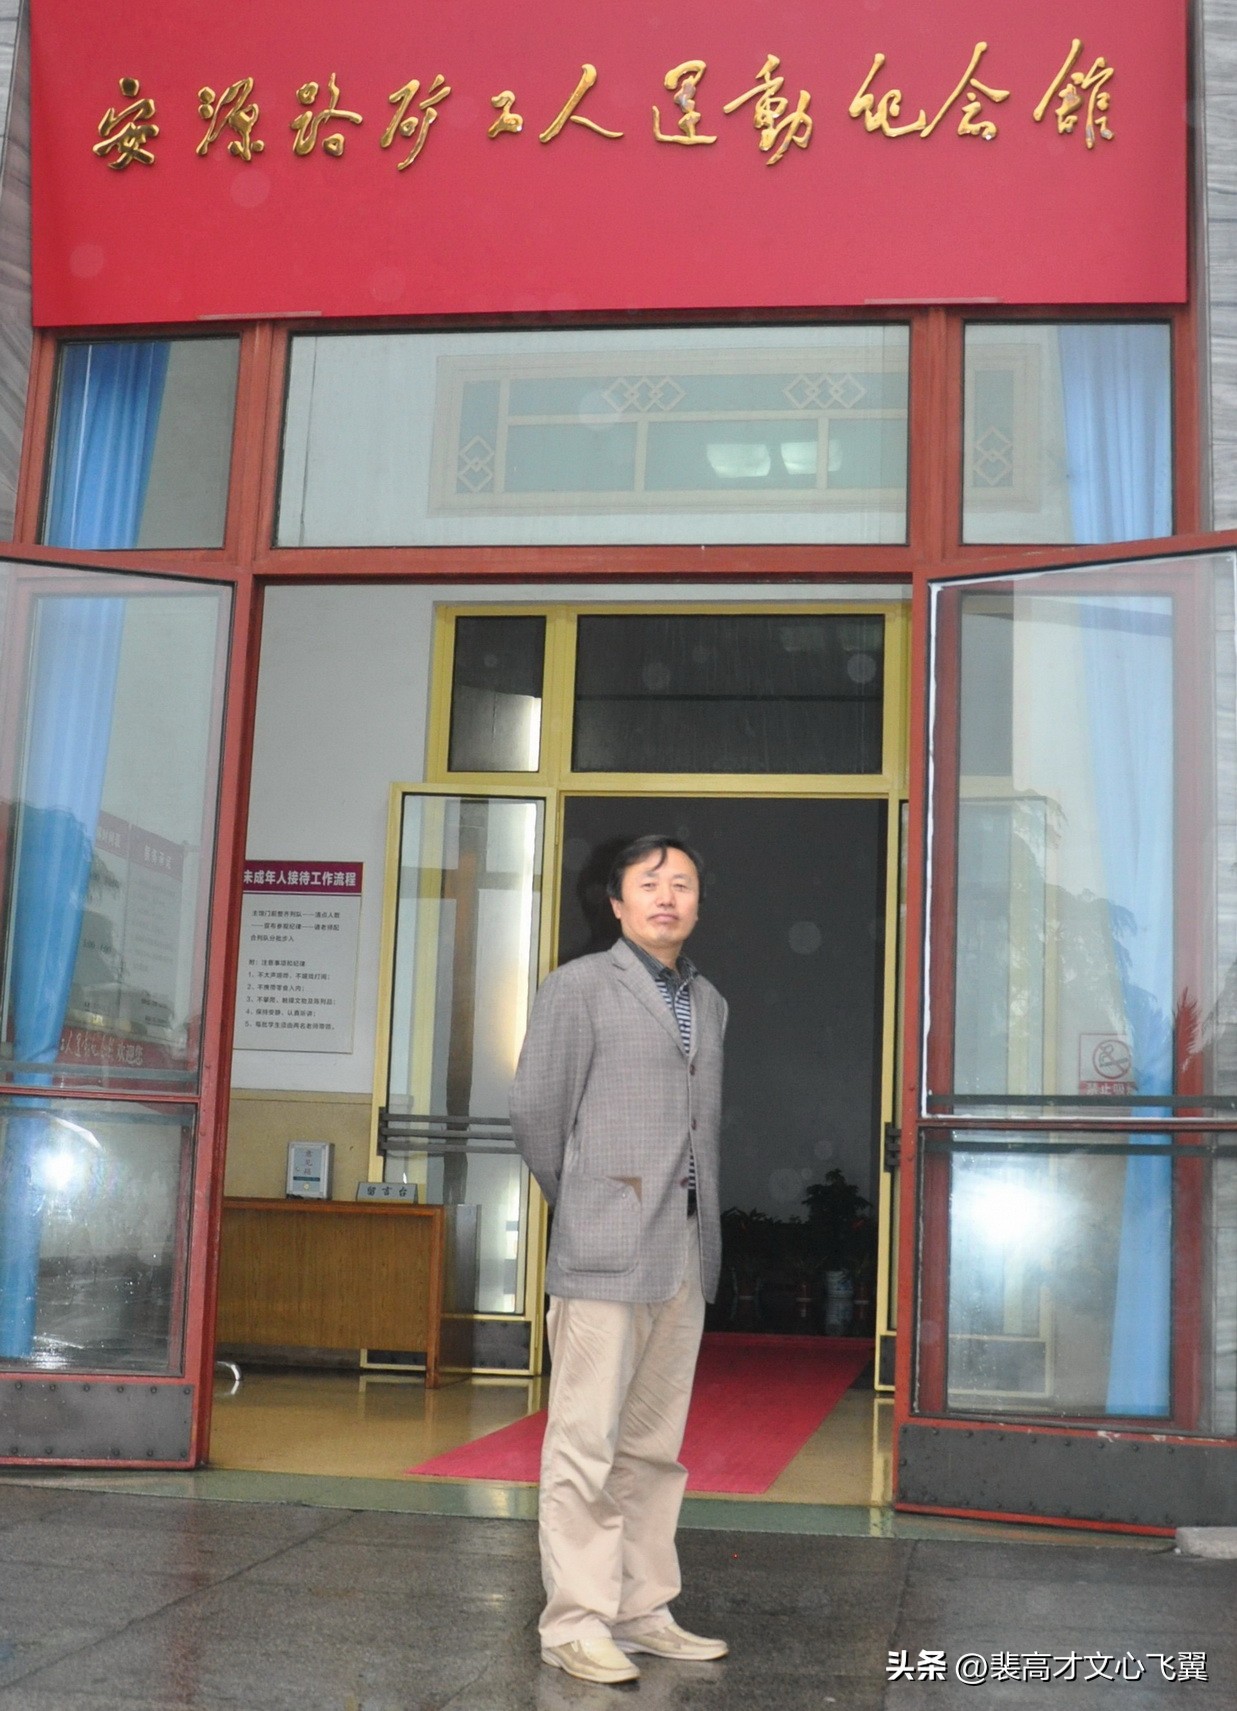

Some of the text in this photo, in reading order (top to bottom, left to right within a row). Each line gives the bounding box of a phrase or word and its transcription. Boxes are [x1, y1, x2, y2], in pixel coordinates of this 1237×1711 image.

[243, 870, 357, 887] 未成年人接待工作流程
[366, 1186, 408, 1198] 留言台
